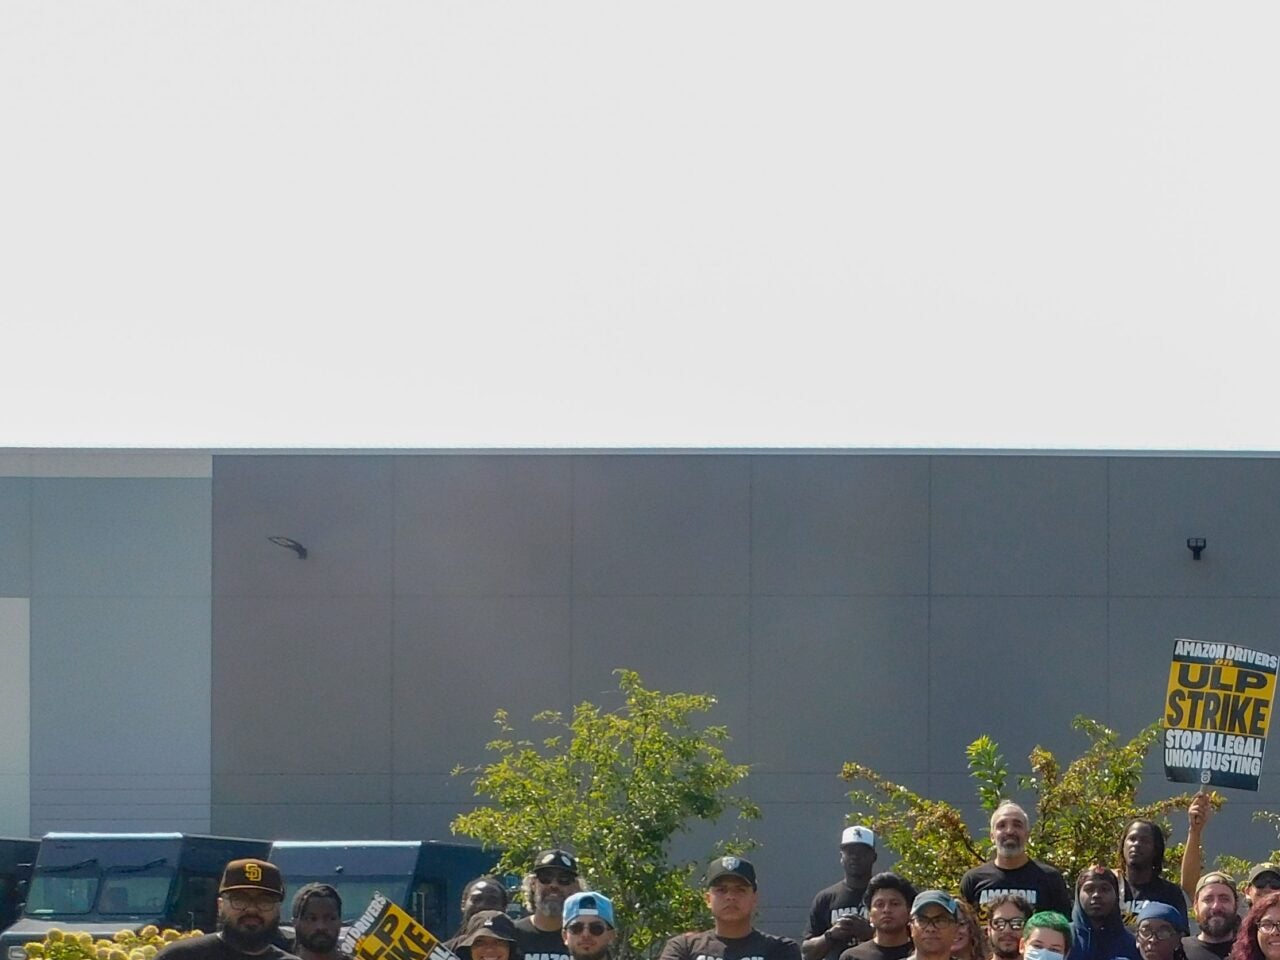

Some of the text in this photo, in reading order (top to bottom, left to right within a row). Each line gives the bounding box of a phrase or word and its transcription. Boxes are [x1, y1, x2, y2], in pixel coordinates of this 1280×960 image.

[1175, 641, 1277, 668] AMAZON DRIVERS
[1178, 664, 1267, 693] ULP
[1167, 689, 1269, 736] STRIKE
[1166, 730, 1262, 757] STOP ILLEGAL
[1166, 749, 1261, 776] UNION BUSTING
